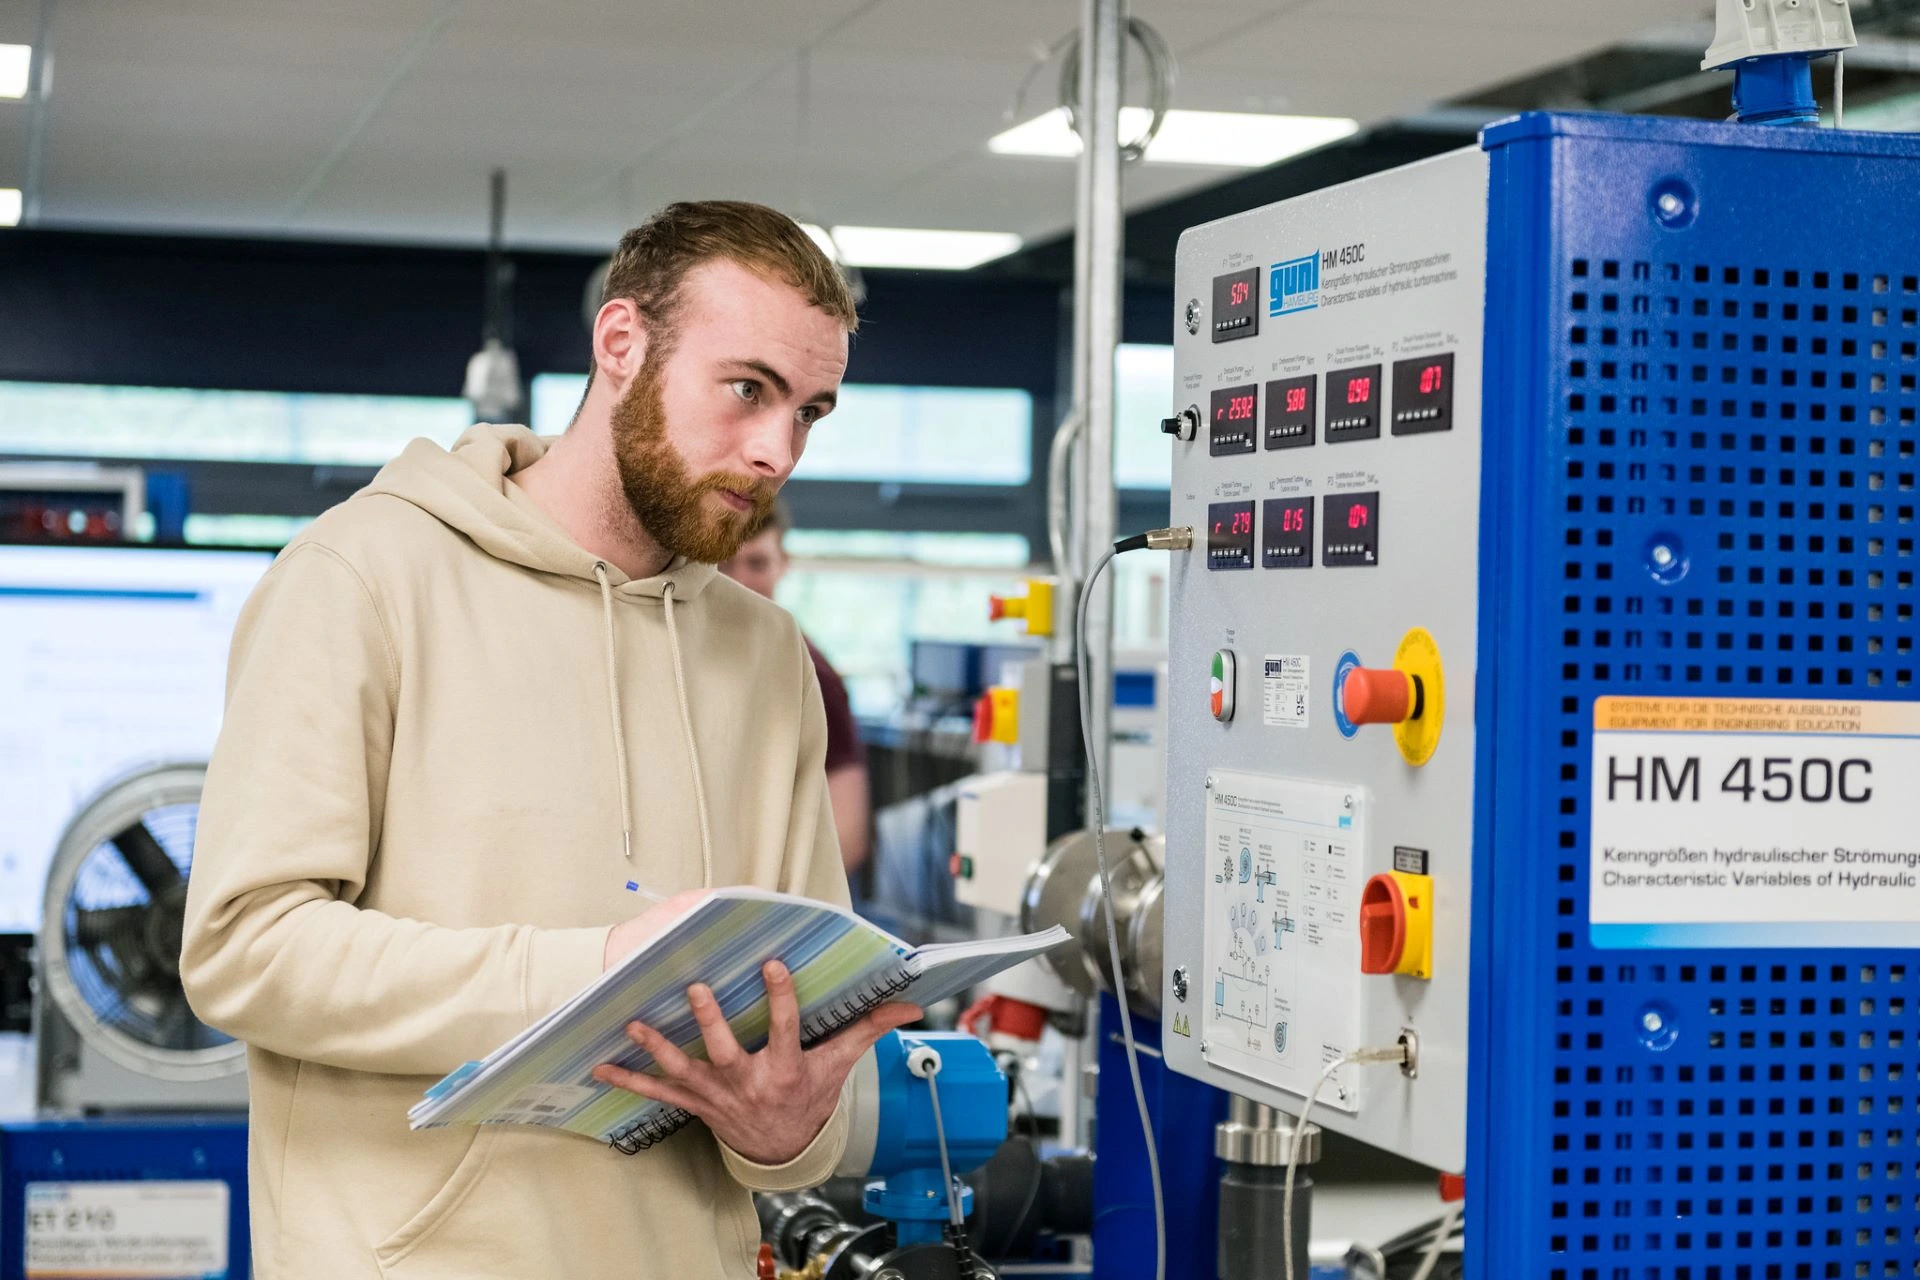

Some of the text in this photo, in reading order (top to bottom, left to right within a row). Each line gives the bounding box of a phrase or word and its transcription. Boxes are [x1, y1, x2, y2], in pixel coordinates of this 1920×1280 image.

[1322, 243, 1365, 271] HM 450C
[1270, 249, 1320, 312] gunt
[1228, 395, 1254, 420] 2592
[1264, 659, 1282, 677] gunt
[1693, 702, 1708, 714] DIE
[1714, 703, 1781, 715] TECHNISCHE
[1787, 703, 1862, 717] AUSBILDUNG
[1609, 717, 1861, 731] EQUIPMENT FOR ENGINEERING EDUCATION
[1608, 756, 1873, 804] HM 450C
[1604, 847, 1708, 867] Kenngrößen
[1713, 847, 1829, 867] hydraulischer
[1603, 870, 1917, 890] Characteristic Variables of Hydraulic
